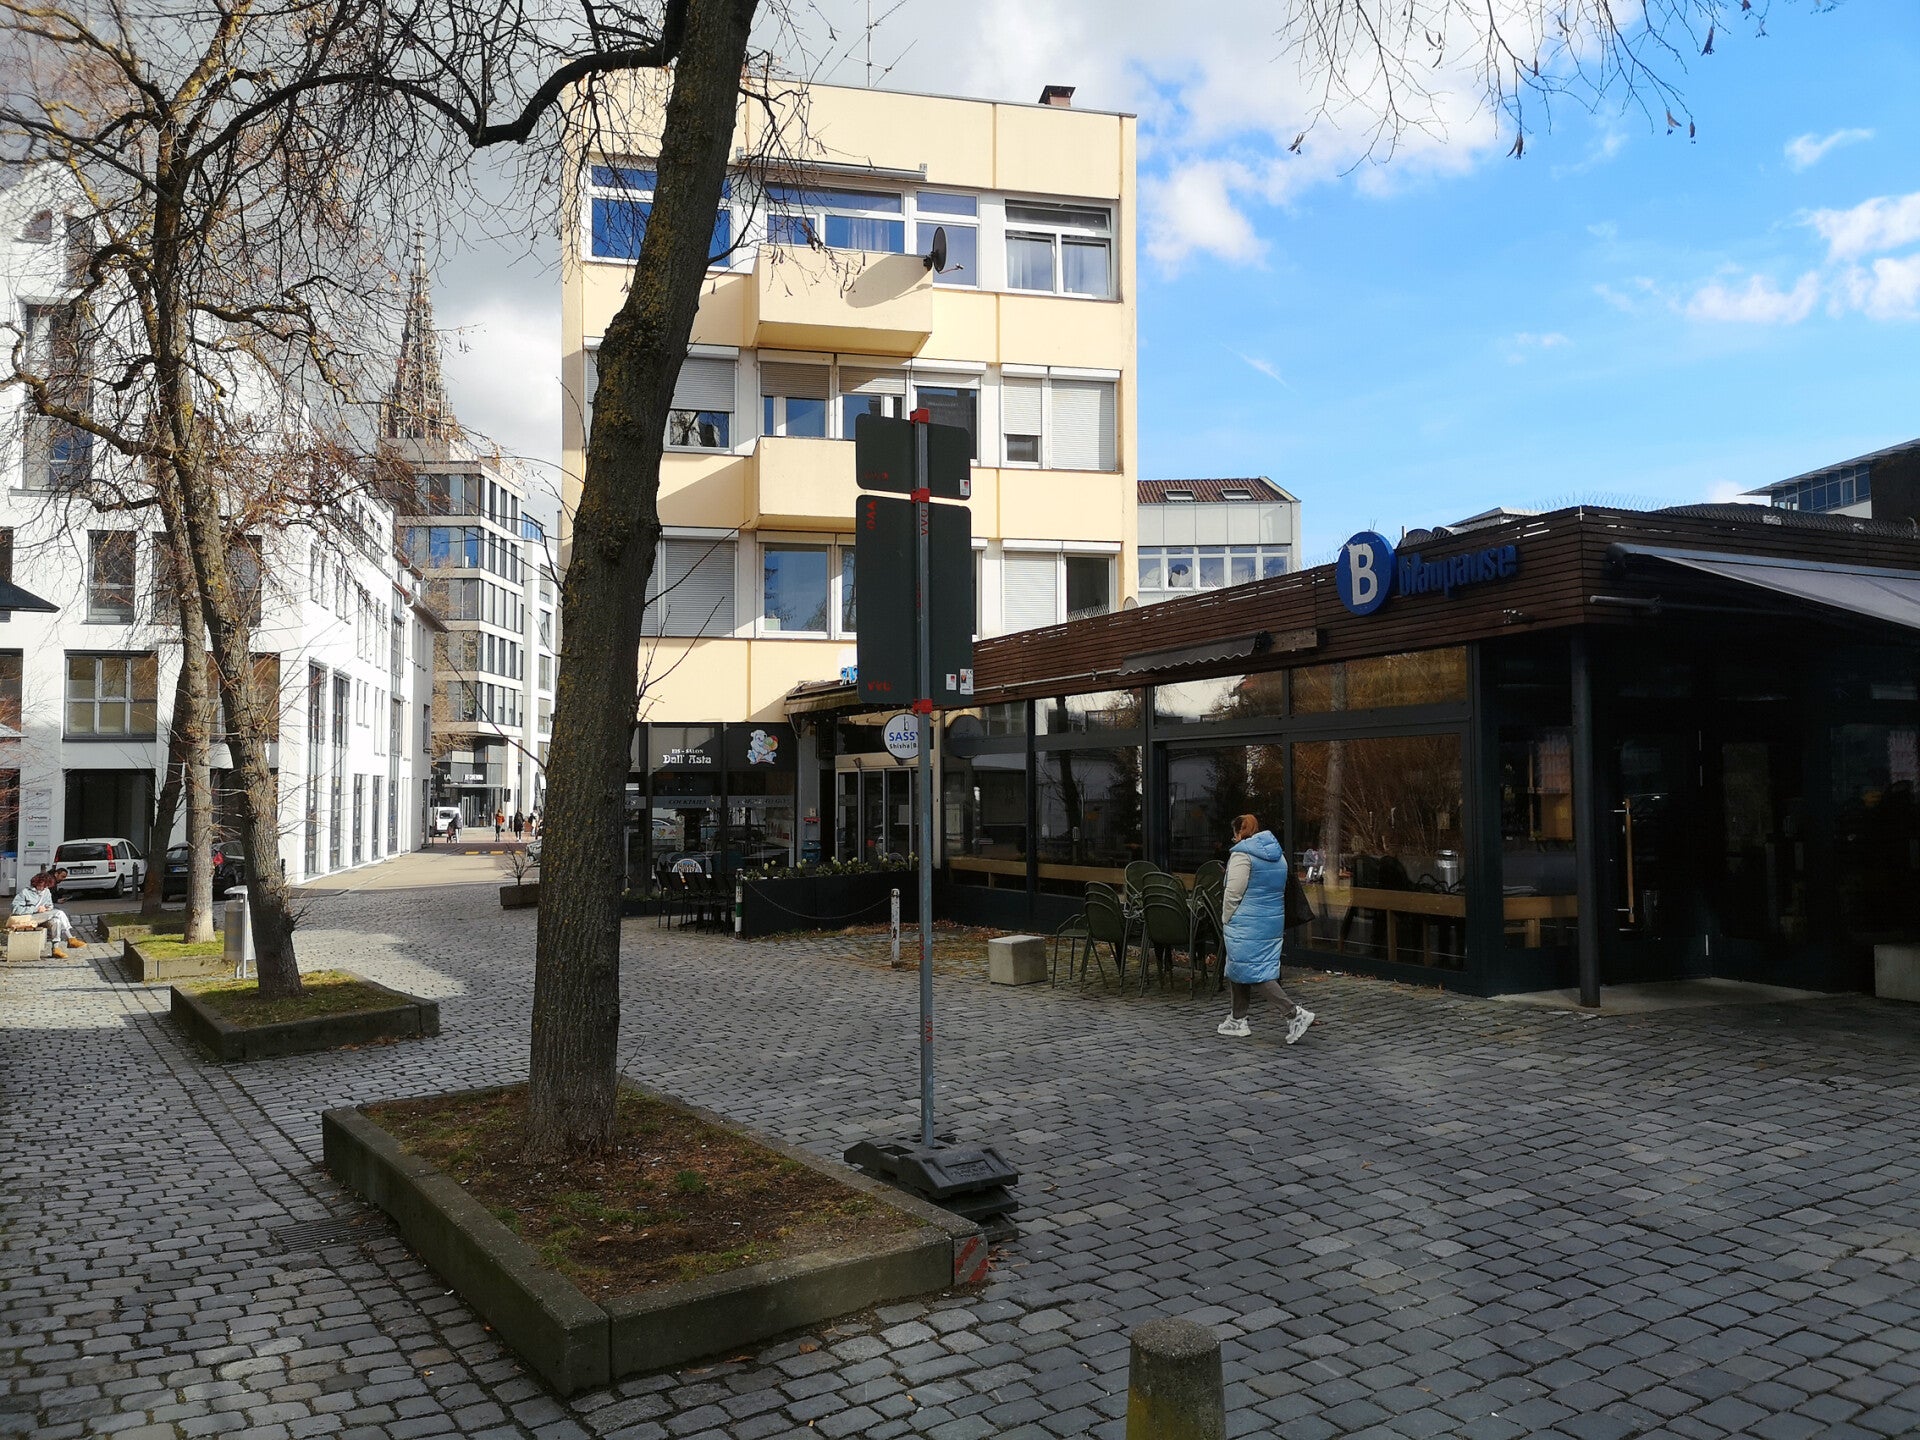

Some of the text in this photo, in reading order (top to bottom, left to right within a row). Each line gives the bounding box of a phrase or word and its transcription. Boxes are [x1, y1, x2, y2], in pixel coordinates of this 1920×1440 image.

[1346, 543, 1378, 605] B
[1399, 545, 1517, 599] blaupause
[688, 754, 712, 764] Asta
